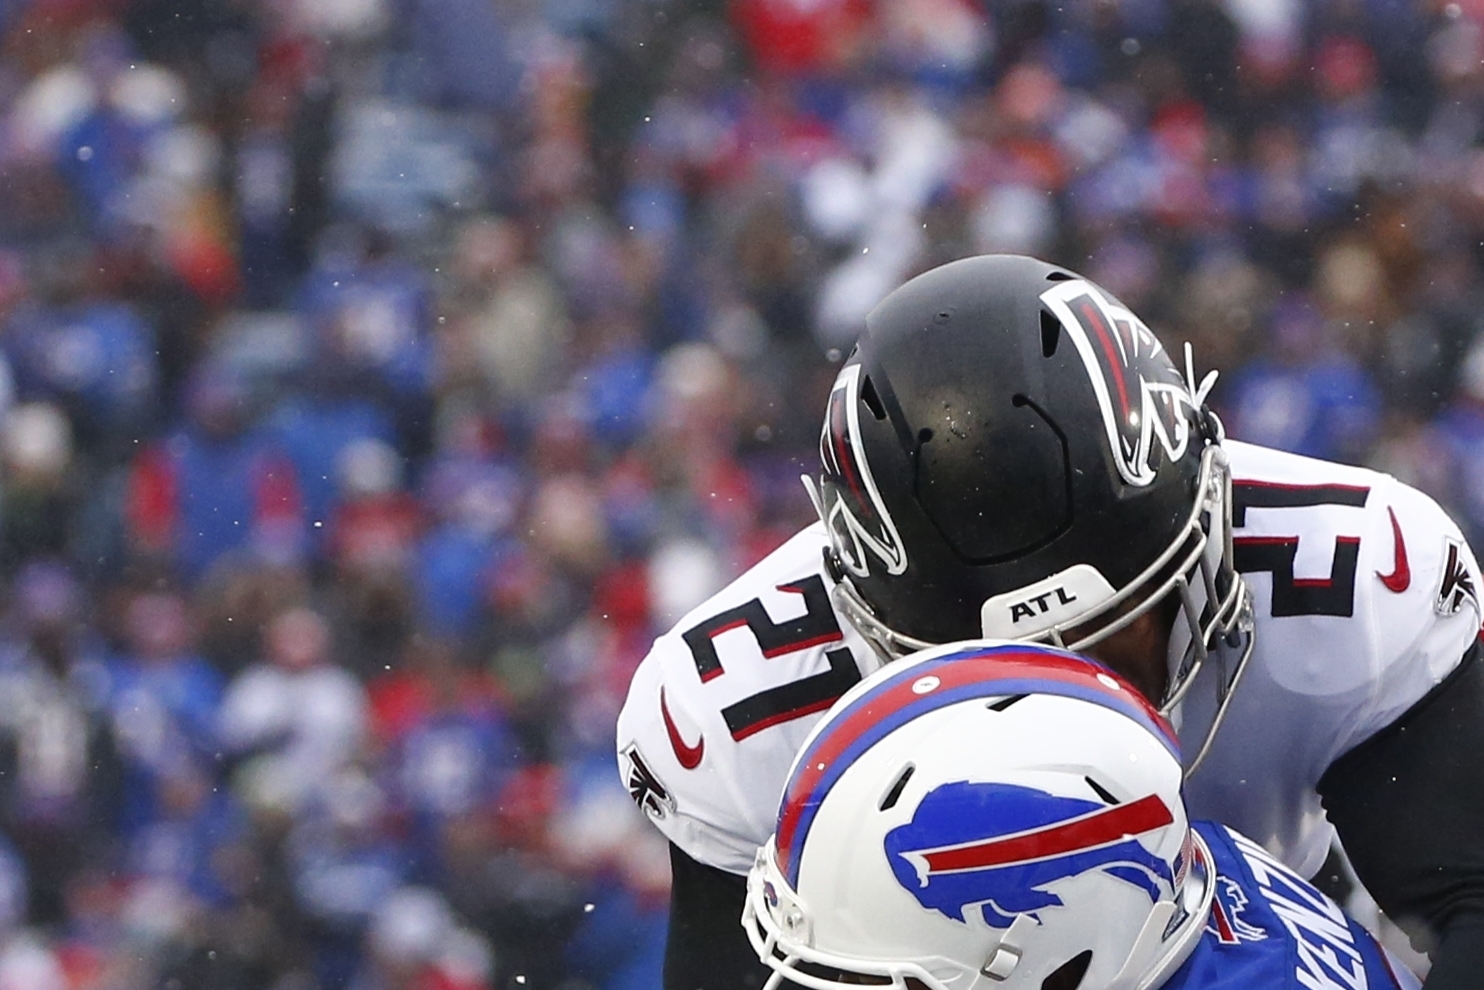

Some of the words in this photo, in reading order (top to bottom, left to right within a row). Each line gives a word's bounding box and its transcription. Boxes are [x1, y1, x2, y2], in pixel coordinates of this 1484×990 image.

[1009, 586, 1077, 624] ATL
[1231, 479, 1371, 617] 21
[682, 573, 862, 742] 21
